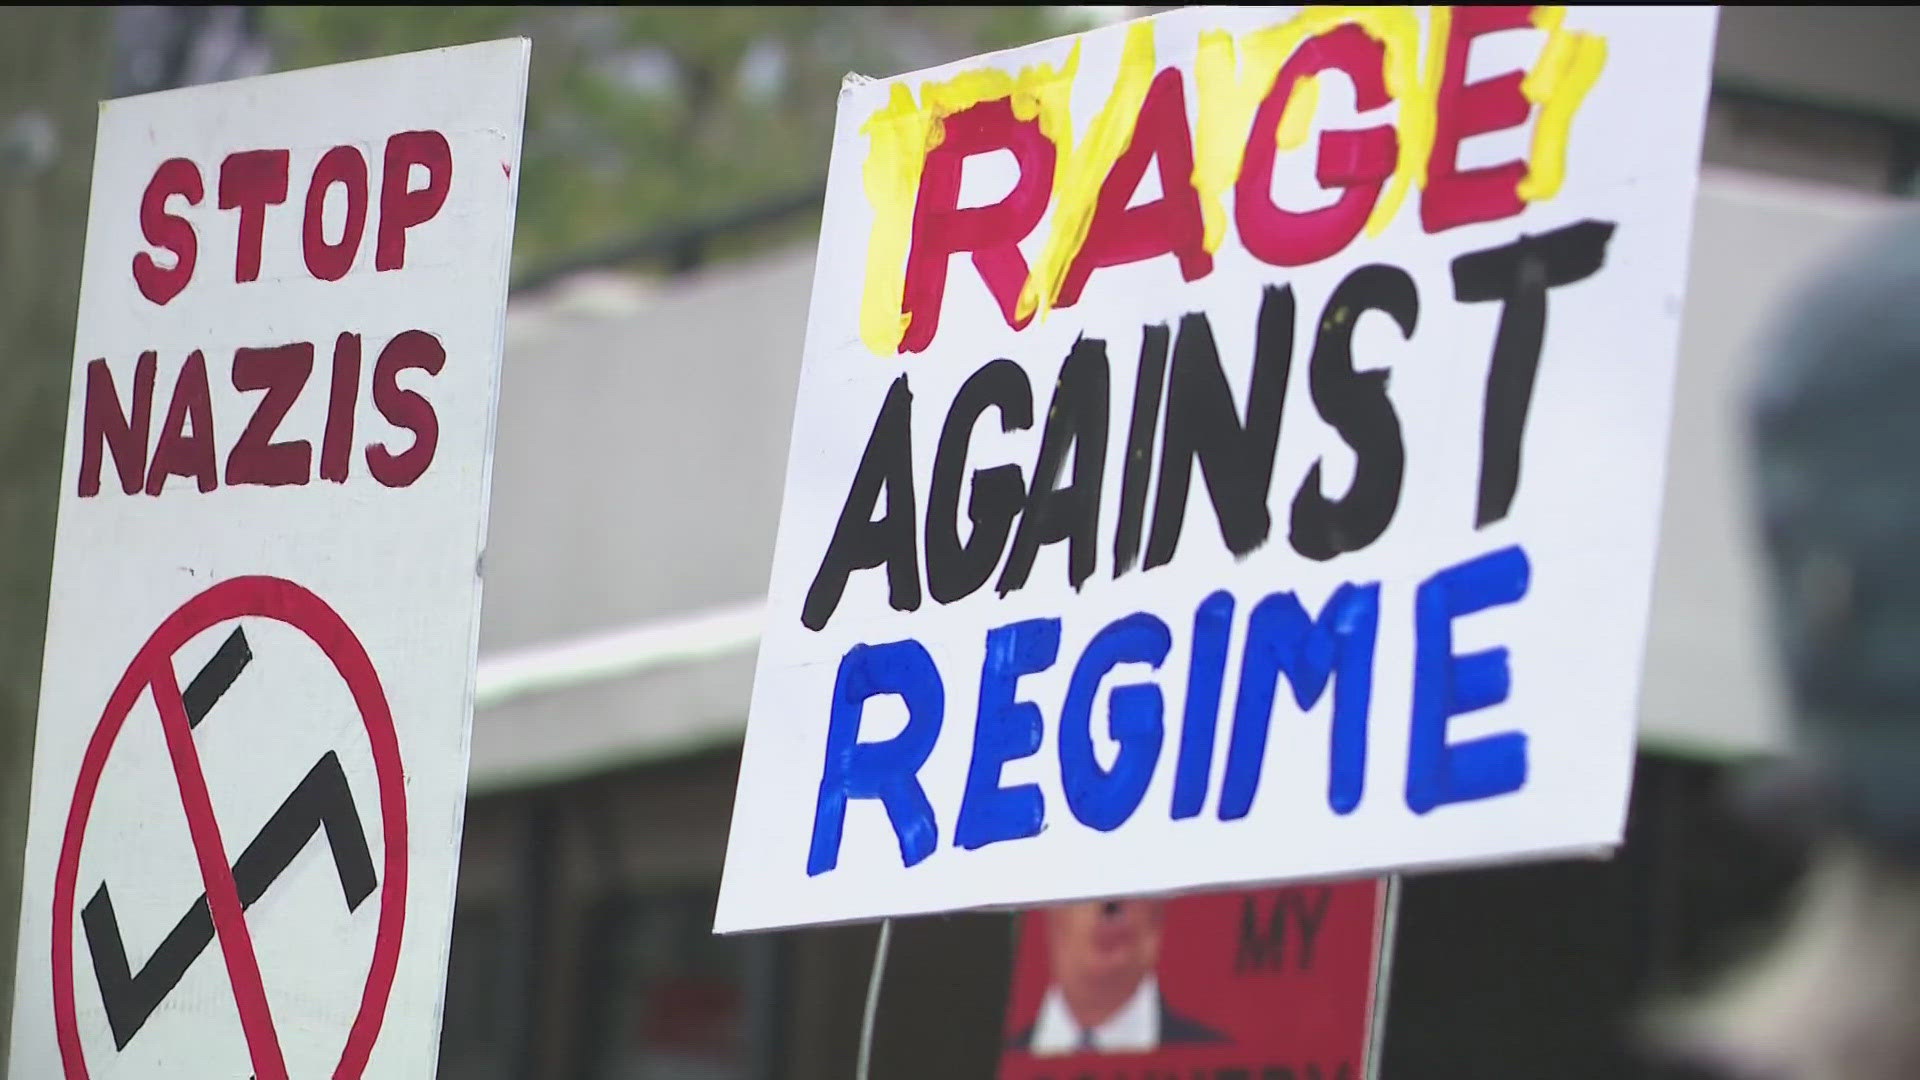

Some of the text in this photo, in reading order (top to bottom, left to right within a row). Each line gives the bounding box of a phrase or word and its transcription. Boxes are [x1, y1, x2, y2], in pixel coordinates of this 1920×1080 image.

[132, 130, 453, 305] STOP
[897, 6, 1536, 354] RAGE
[78, 330, 446, 497] NAZIS
[801, 220, 1617, 631] AGAINST
[807, 545, 1531, 877] REGIME
[1233, 886, 1333, 975] MY
